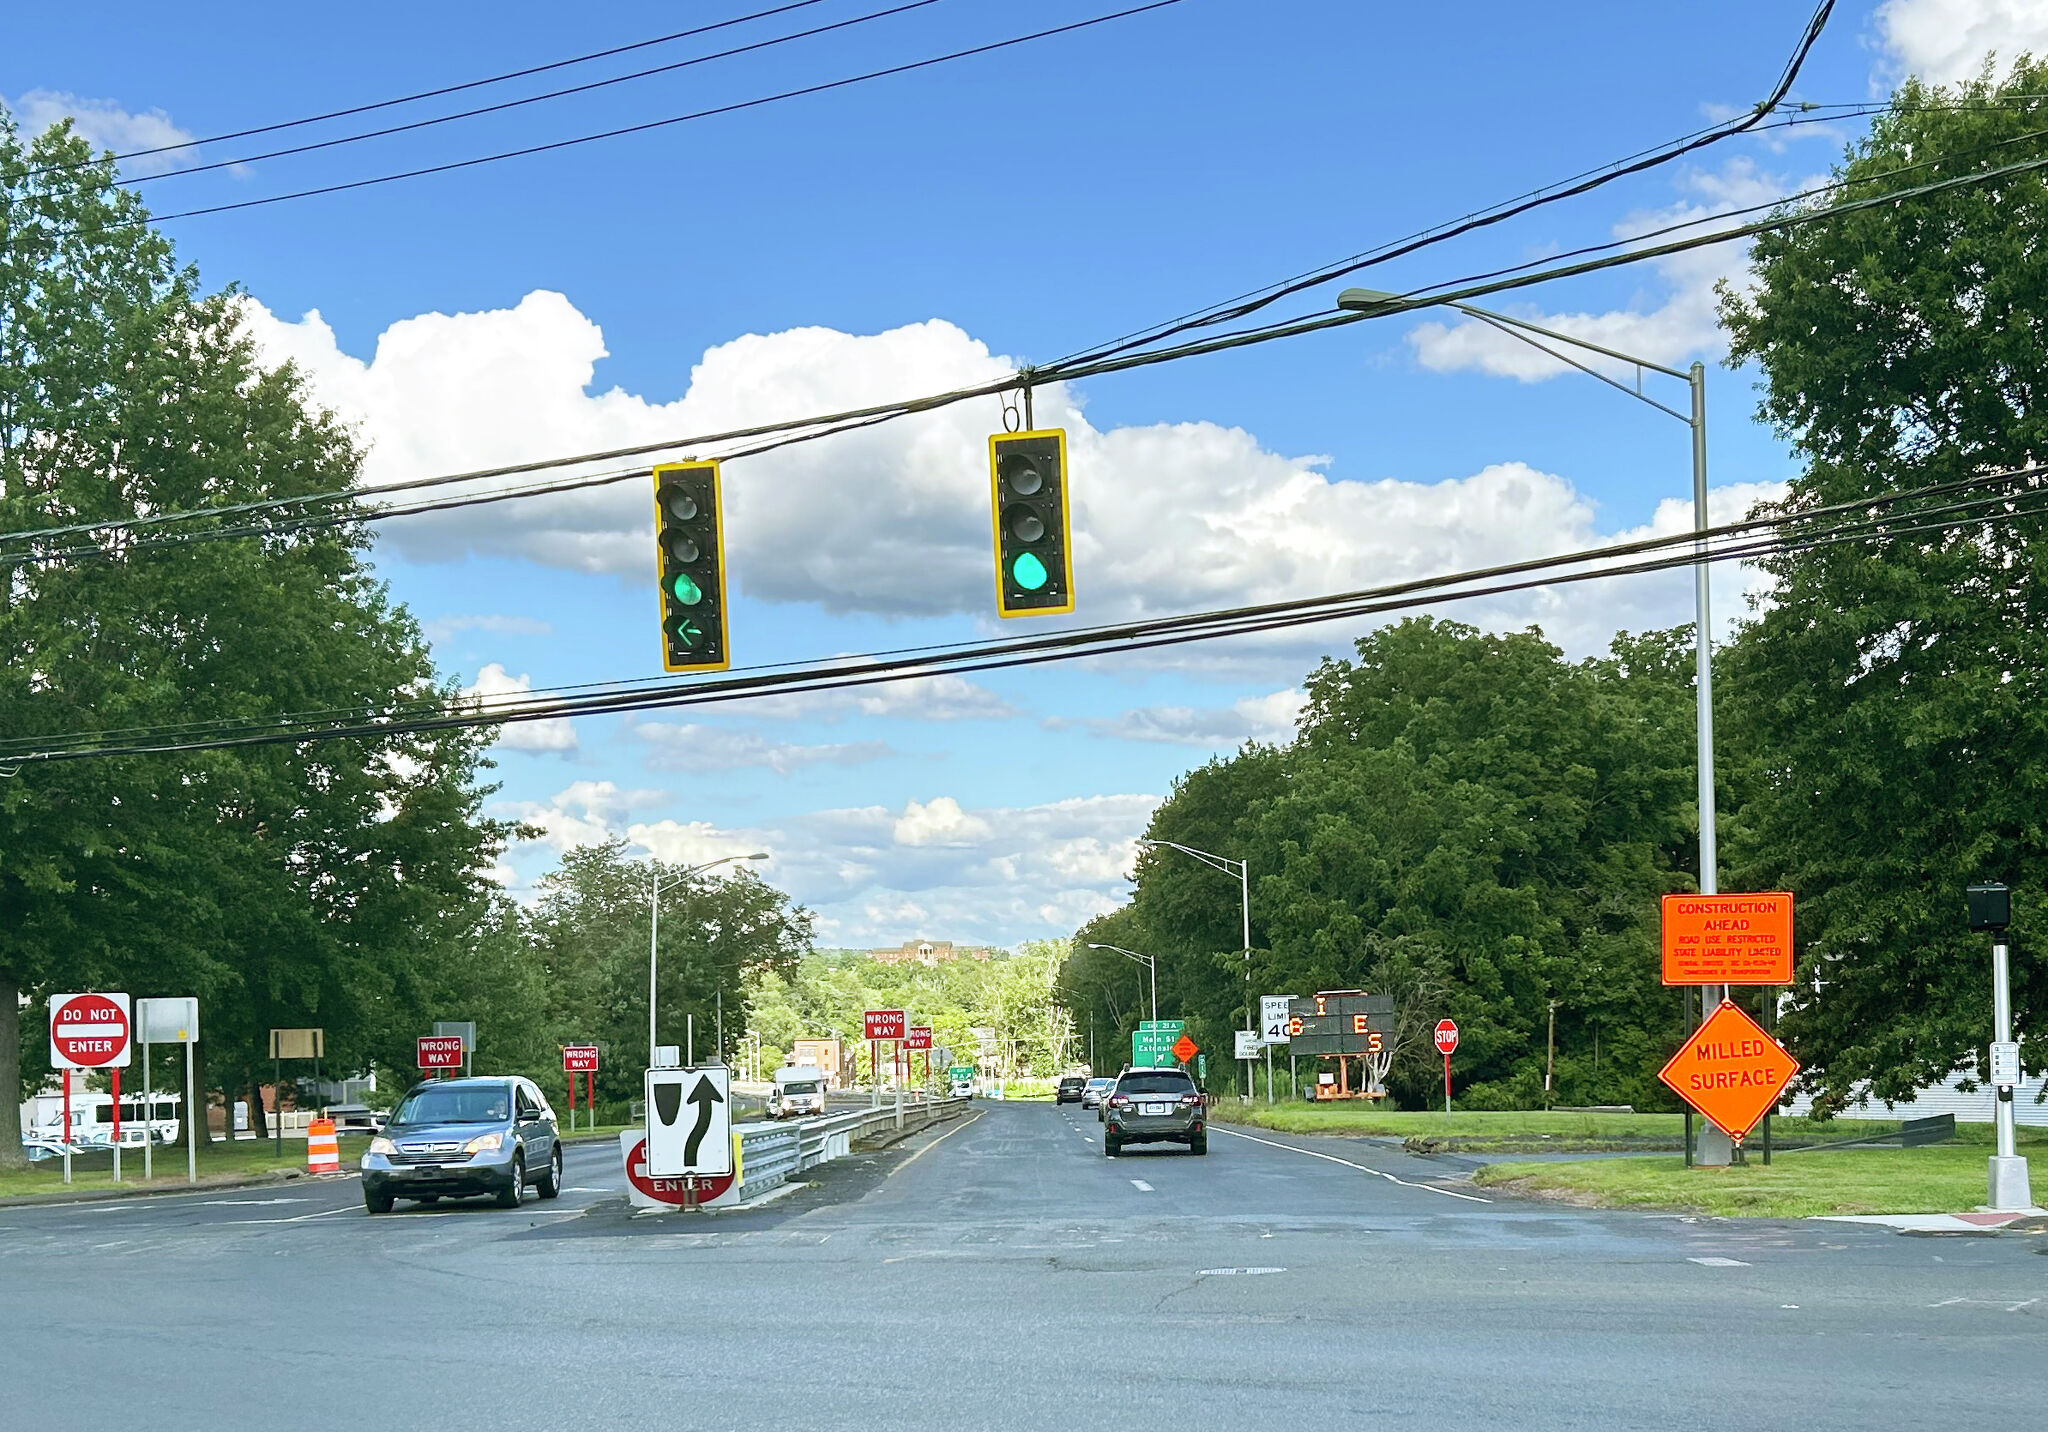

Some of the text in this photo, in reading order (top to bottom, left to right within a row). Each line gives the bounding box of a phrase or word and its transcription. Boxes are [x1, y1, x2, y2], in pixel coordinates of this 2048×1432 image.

[1677, 901, 1777, 915] CONSTRUCTION
[1704, 919, 1750, 931] AHEAD
[1678, 934, 1776, 944] ROAD USE RESTRICTED
[1673, 947, 1781, 957] STATE LIABILITY LIMITED
[1264, 1001, 1289, 1009] SPEE
[63, 1009, 117, 1021] DO NOT
[866, 1014, 903, 1024] WRONG
[1267, 1012, 1289, 1021] LIMI
[1353, 1014, 1369, 1034] E
[873, 1026, 896, 1036] WAY
[910, 1029, 931, 1038] RONG
[1437, 1030, 1457, 1043] STOP
[69, 1040, 112, 1053] ENTER
[421, 1041, 459, 1051] WRONG
[909, 1039, 925, 1047] WAY
[566, 1050, 595, 1058] WRONG
[1696, 1040, 1764, 1061] MILLED
[428, 1053, 451, 1063] WAY
[1690, 1068, 1777, 1091] SURFACE
[653, 1179, 713, 1192] ENTER
